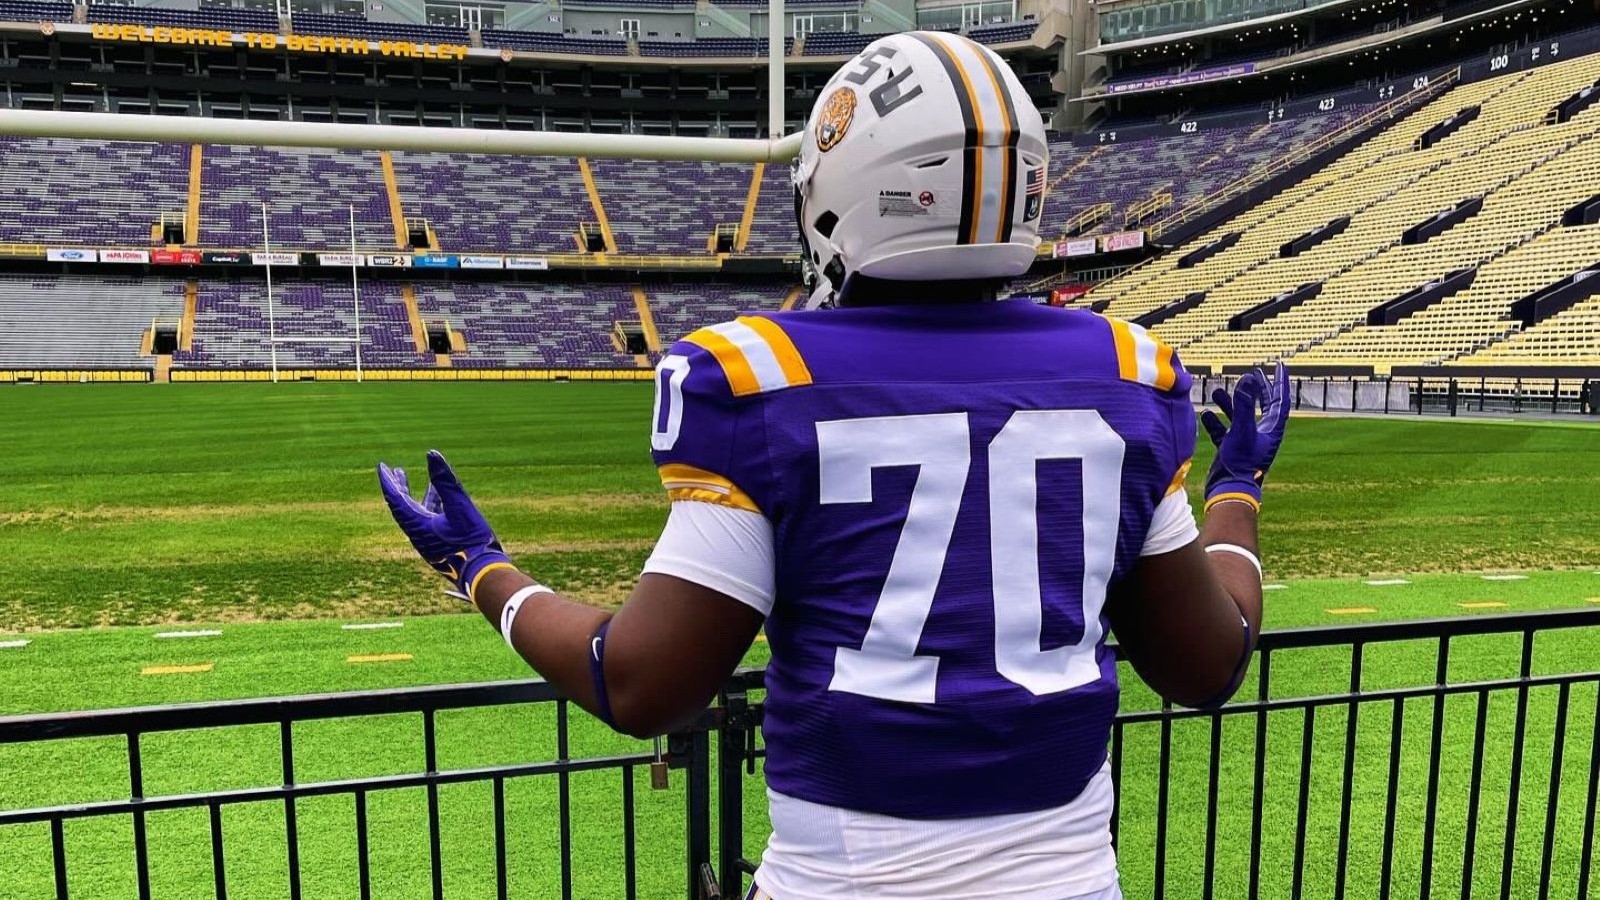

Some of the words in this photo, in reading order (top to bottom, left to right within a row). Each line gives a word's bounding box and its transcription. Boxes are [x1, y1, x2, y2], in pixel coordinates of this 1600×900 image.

[91, 23, 233, 46] WELCOME
[245, 33, 277, 49] TO
[286, 35, 368, 55] DEATH
[379, 41, 468, 60] VALLEY
[1490, 54, 1509, 71] 100
[827, 46, 923, 118] SU
[1413, 75, 1429, 90] 424
[1319, 97, 1335, 111] 423
[1181, 122, 1197, 132] 422
[651, 354, 691, 451] 0
[815, 409, 1126, 704] 70
